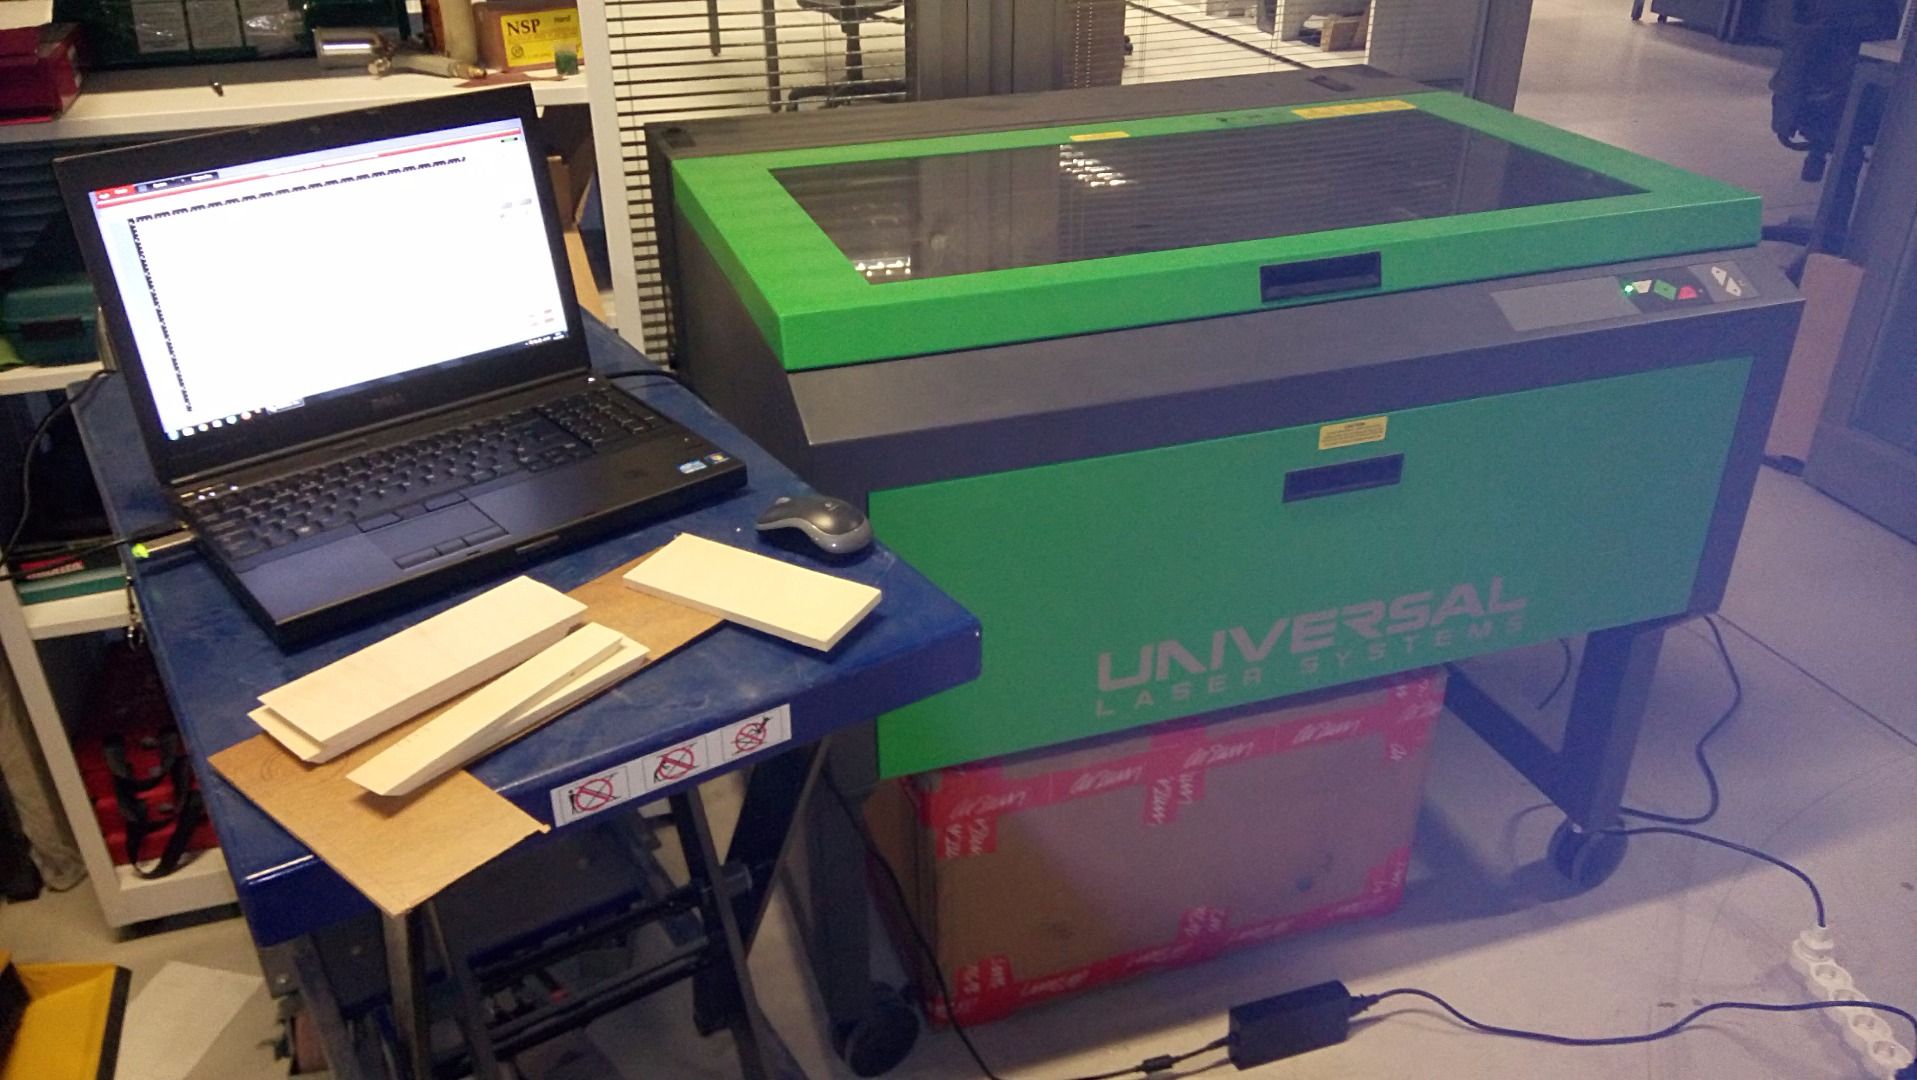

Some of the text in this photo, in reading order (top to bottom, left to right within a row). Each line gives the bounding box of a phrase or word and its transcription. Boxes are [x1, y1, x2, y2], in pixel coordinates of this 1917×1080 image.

[507, 18, 541, 36] NSP
[1095, 615, 1524, 716] LASER SYSTEMS
[1097, 575, 1527, 692] UNIVERSAL
